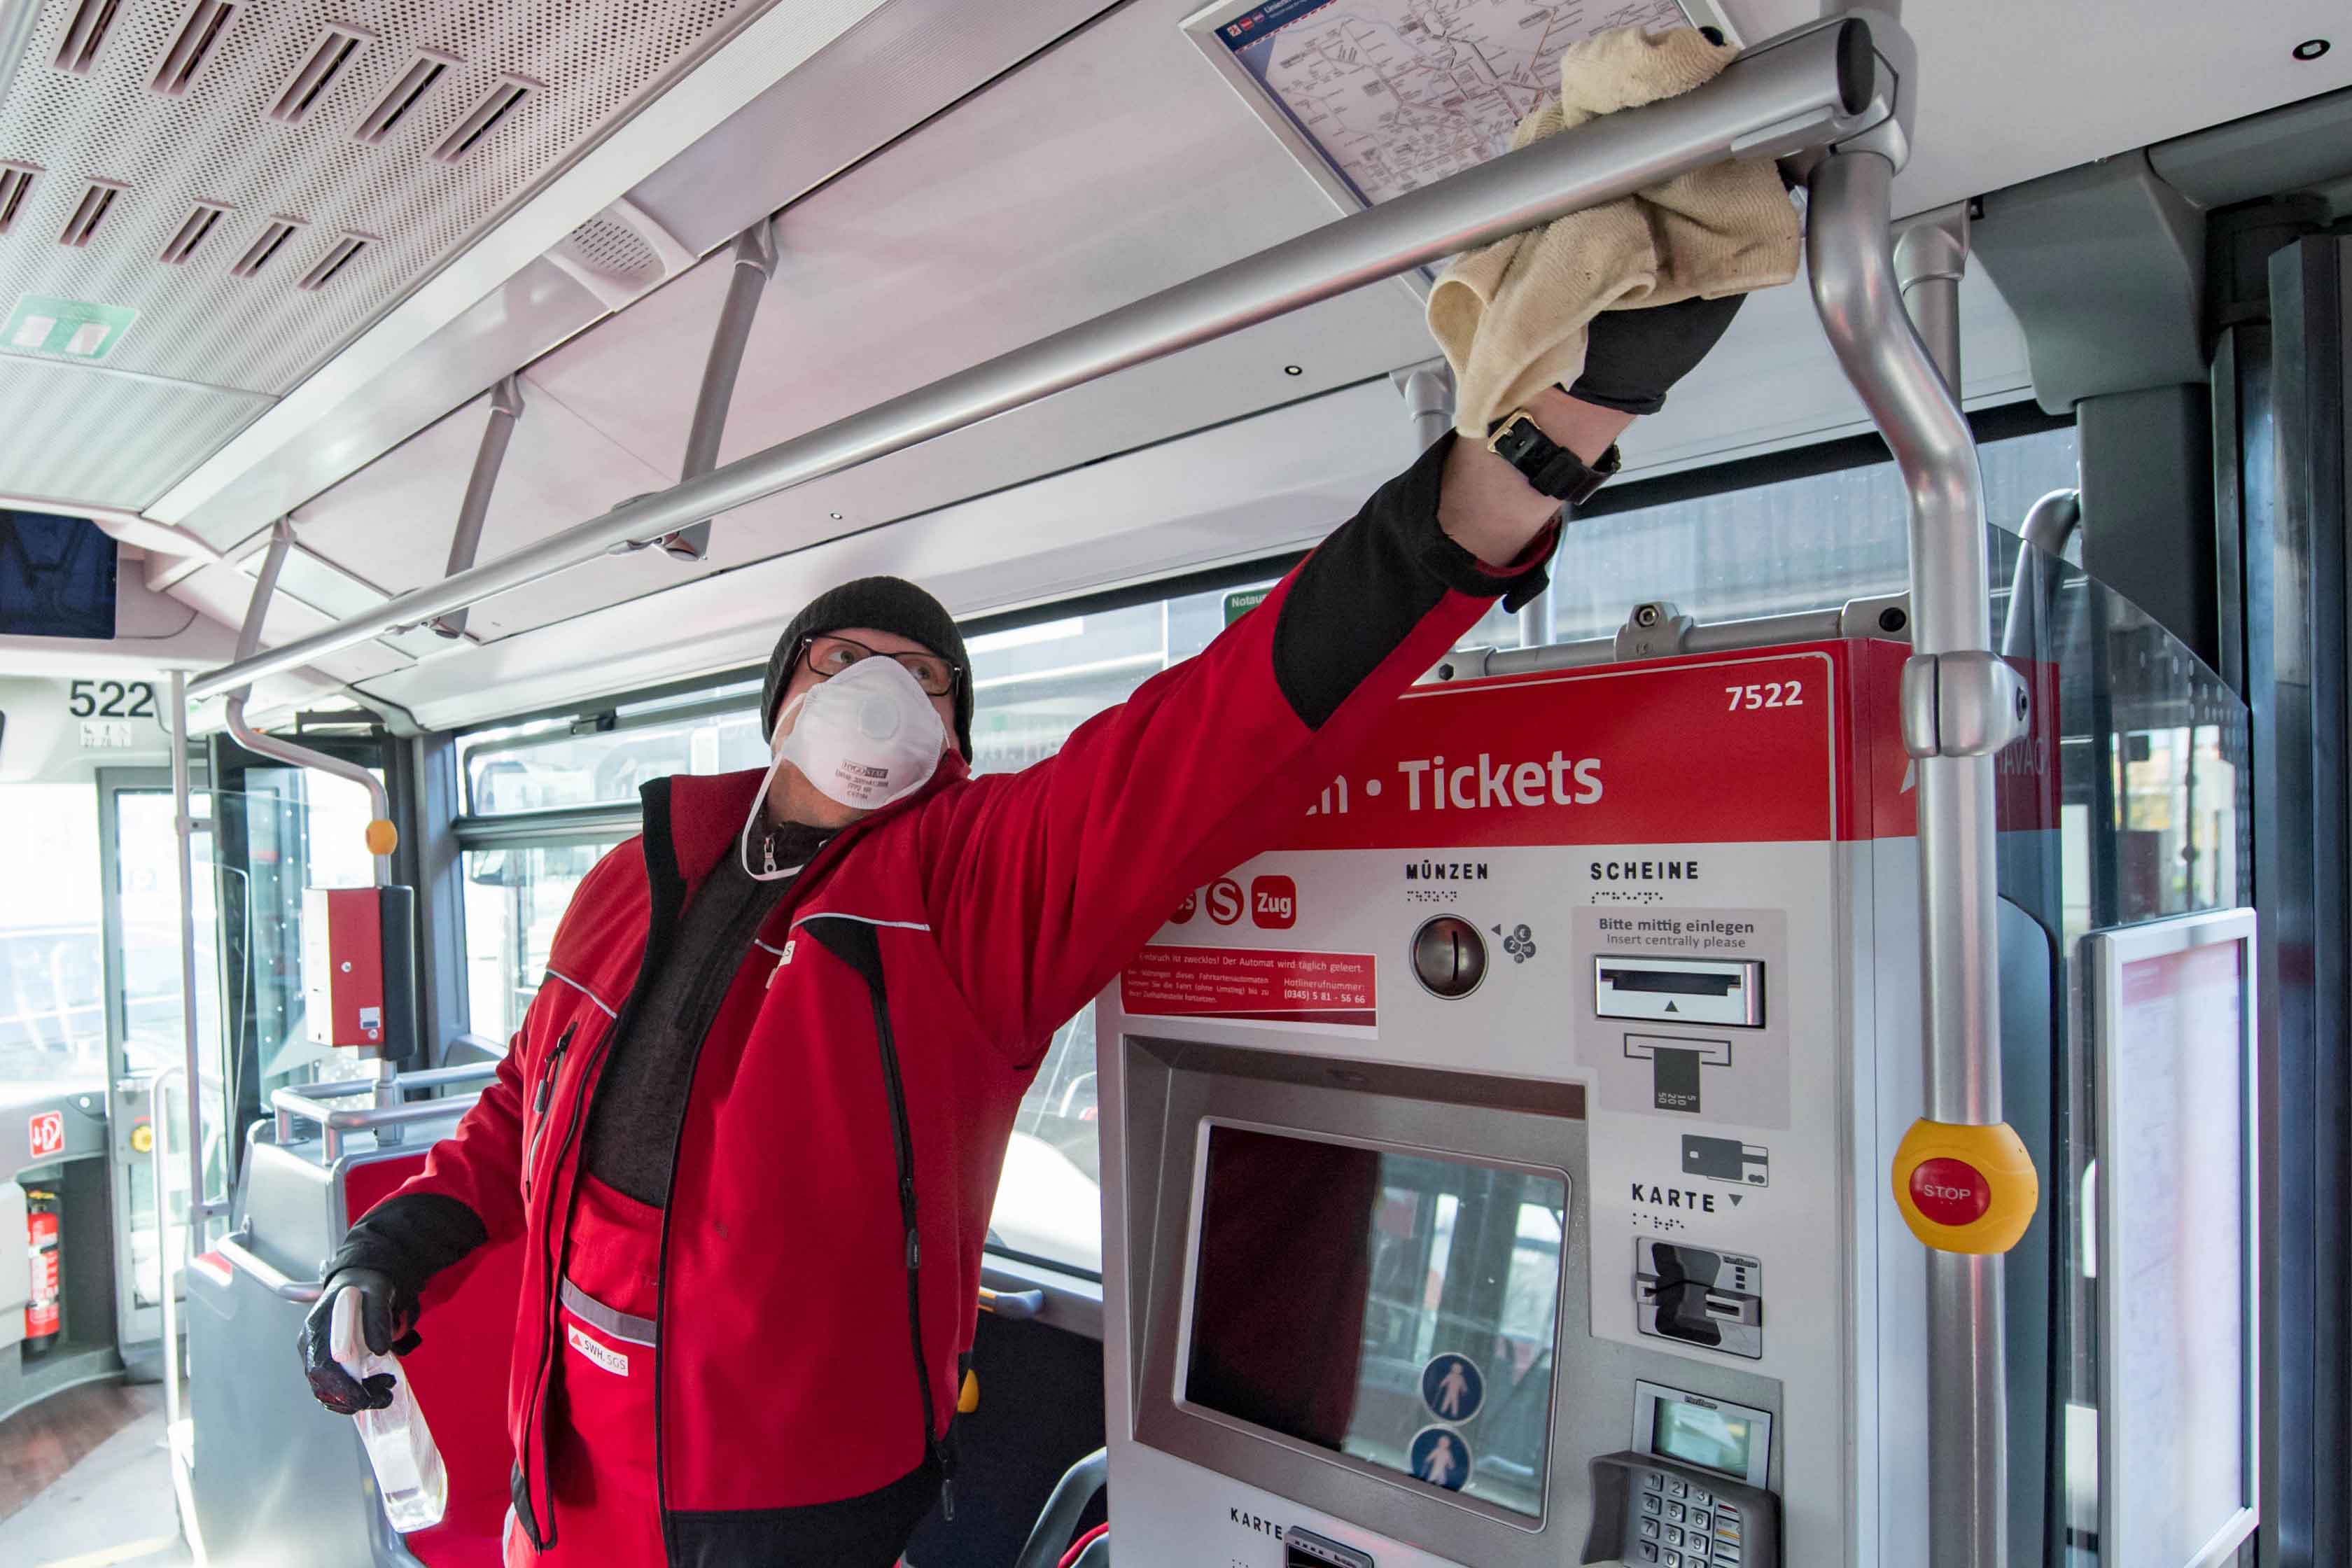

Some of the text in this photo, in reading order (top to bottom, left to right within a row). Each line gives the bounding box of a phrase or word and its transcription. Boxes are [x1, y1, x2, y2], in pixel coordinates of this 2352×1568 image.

[69, 680, 153, 718] 522
[1726, 680, 1803, 710] 7522
[1399, 750, 1604, 811] Tickets
[1406, 859, 1489, 880] MÜNZEN
[1590, 861, 1699, 880] SCHEINE
[1257, 892, 1292, 918] Zug
[1599, 918, 1754, 935] Bitte mittig einlegen
[1607, 934, 1746, 949] Insert centrally please
[1184, 955, 1220, 965] zwecklos!
[1222, 956, 1236, 965] Der
[1240, 957, 1274, 967] Automat
[1277, 959, 1296, 969] wird
[1298, 960, 1327, 972] täglich
[1329, 962, 1364, 974] geleert.
[1284, 977, 1365, 992] Hotlinerufnummer:
[1284, 989, 1310, 1001] (0345)
[1312, 991, 1317, 1000] 5
[1321, 992, 1331, 1001] 81
[1341, 993, 1351, 1003] 56
[1355, 995, 1366, 1004] 66
[1658, 1092, 1667, 1103] 50
[1667, 1093, 1676, 1105] 20
[1632, 1183, 1715, 1212] KARTE
[1924, 1184, 1971, 1200] STOP
[607, 1354, 626, 1370] SGS
[1672, 1481, 1681, 1494] 2
[1697, 1489, 1705, 1502] 3
[1646, 1499, 1654, 1510] 4
[1670, 1506, 1678, 1518] 5
[1230, 1506, 1283, 1541] KARTE
[1695, 1513, 1704, 1525] 6
[1645, 1522, 1653, 1534] 7
[1668, 1530, 1676, 1541] 8
[1693, 1538, 1702, 1550] 9
[1666, 1553, 1675, 1566] 0
